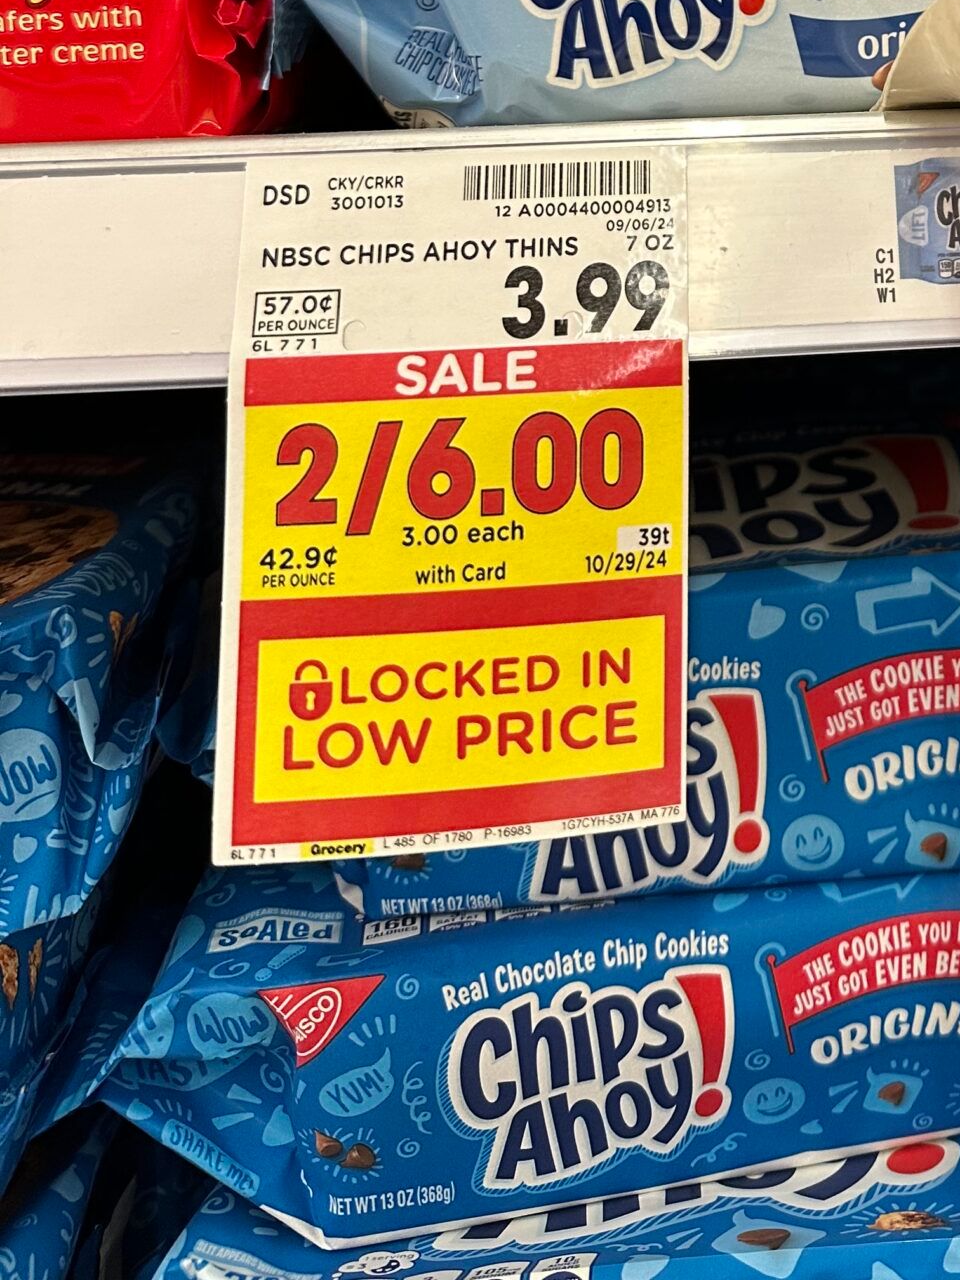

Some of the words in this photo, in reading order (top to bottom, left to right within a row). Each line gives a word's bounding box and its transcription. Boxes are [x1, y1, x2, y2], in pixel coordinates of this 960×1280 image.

[73, 5, 143, 30] with
[53, 41, 146, 64] creme
[395, 41, 434, 75] CHIP
[263, 184, 311, 207] DSD
[328, 175, 404, 193] CKY/CRKR
[331, 194, 404, 211] 3001013
[495, 205, 511, 218] 12
[518, 198, 671, 218] A0004400004913
[606, 217, 675, 233] 09/06/24
[262, 245, 331, 269] NBSC
[340, 242, 415, 266] CHIPS
[423, 239, 497, 262] AHOY
[505, 236, 579, 260] THINS
[626, 235, 638, 252] 7
[645, 233, 675, 253] OZ
[875, 248, 895, 264] C1
[874, 268, 895, 284] H2
[501, 260, 671, 340] 3.99
[877, 288, 897, 303] W1
[258, 320, 286, 333] PER
[288, 317, 336, 332] OUNCE
[395, 350, 538, 396] SALE
[275, 407, 645, 537] 2/6.00
[401, 524, 459, 547] 3.00
[467, 521, 525, 543] each
[638, 525, 671, 547] 39t
[416, 564, 457, 586] with
[462, 560, 506, 583] Card
[586, 550, 668, 574] 10/29/24
[262, 573, 287, 588] PER
[290, 571, 336, 587] OUNCE
[340, 654, 561, 705] LOCKED
[582, 647, 631, 688] IN
[688, 655, 762, 682] Cookies
[835, 680, 868, 707] THE
[870, 655, 945, 693] COOKIE
[826, 706, 864, 738] JUST
[870, 695, 901, 721] GOT
[908, 683, 960, 713] EVEN
[283, 717, 432, 771] LOW
[456, 700, 638, 760] PRICE
[640, 808, 658, 821] MA
[660, 805, 681, 819] 776
[423, 833, 442, 846] OF
[445, 831, 473, 844] 1780
[484, 825, 532, 841] P-16983
[311, 841, 366, 858] Grocery
[381, 898, 408, 916] NET
[409, 897, 429, 914] WT
[431, 896, 446, 912] 13
[448, 895, 464, 911] OZ
[803, 953, 836, 984] THE
[838, 921, 911, 967] COOKIE
[918, 920, 952, 945] YOU
[442, 973, 489, 1011] Real
[495, 949, 596, 993] Chocolate
[603, 938, 648, 971] Chip
[655, 929, 729, 960] Cookies
[793, 981, 832, 1015] JUST
[838, 967, 868, 996] GOT
[876, 950, 927, 987] EVEN
[460, 989, 685, 1120] Chips
[329, 1195, 353, 1218] NET
[355, 1194, 378, 1214] WT
[380, 1192, 394, 1211] 13
[398, 1189, 414, 1208] OZ
[417, 1181, 456, 1207] (368g)
